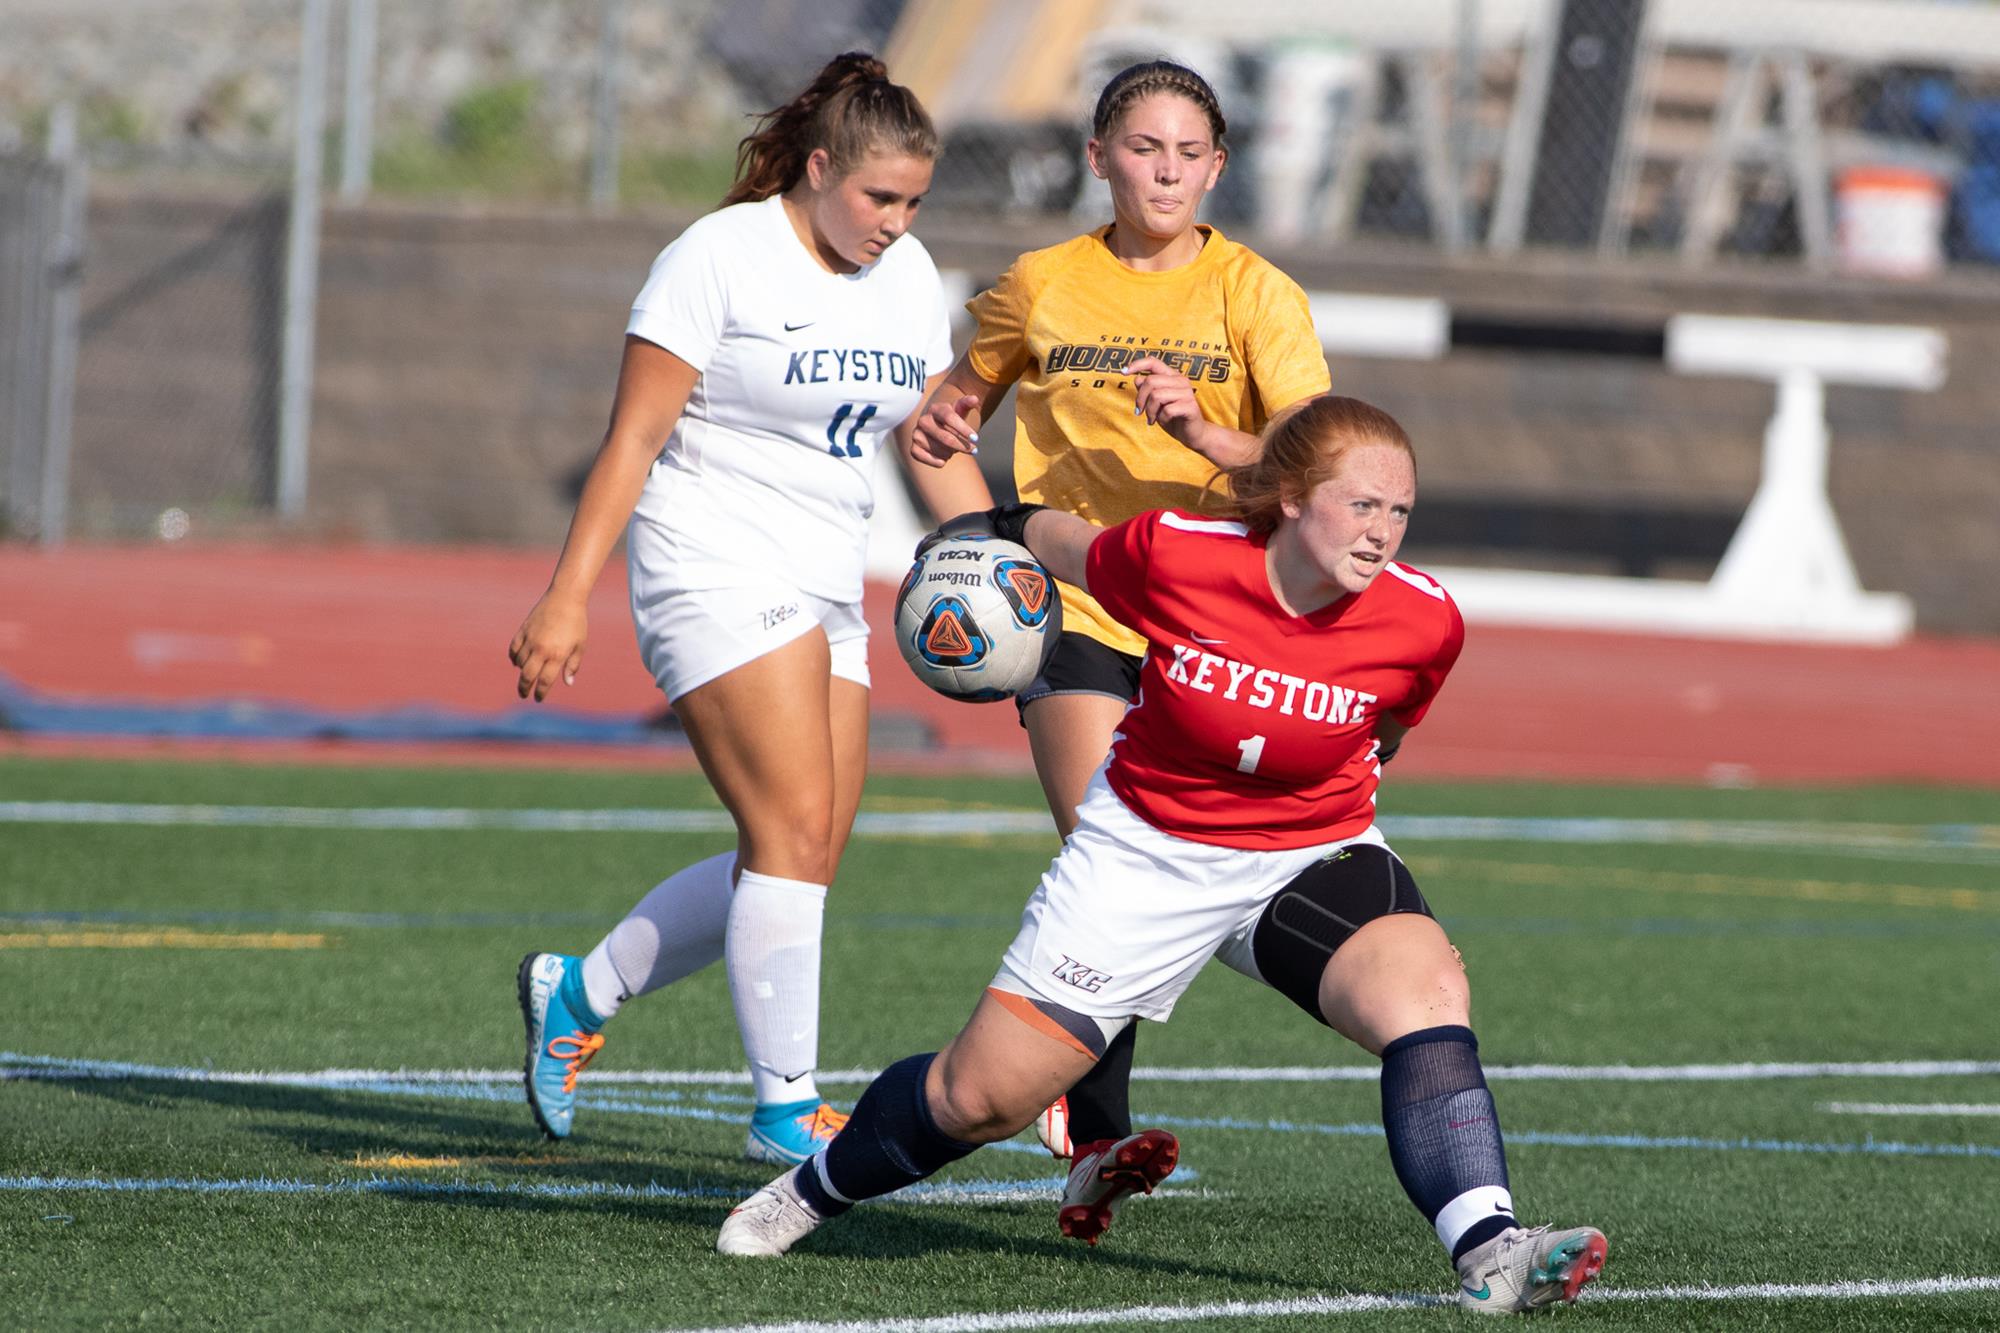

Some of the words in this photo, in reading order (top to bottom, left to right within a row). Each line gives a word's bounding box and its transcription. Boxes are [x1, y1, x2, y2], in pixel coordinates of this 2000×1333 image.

[1100, 334, 1149, 345] SUNY
[827, 403, 877, 457] 11
[938, 550, 985, 562] NCAA
[929, 572, 982, 588] Wilson
[1166, 644, 1378, 725] KEYSTONE
[1236, 734, 1266, 775] 1
[1052, 954, 1113, 994] KC
